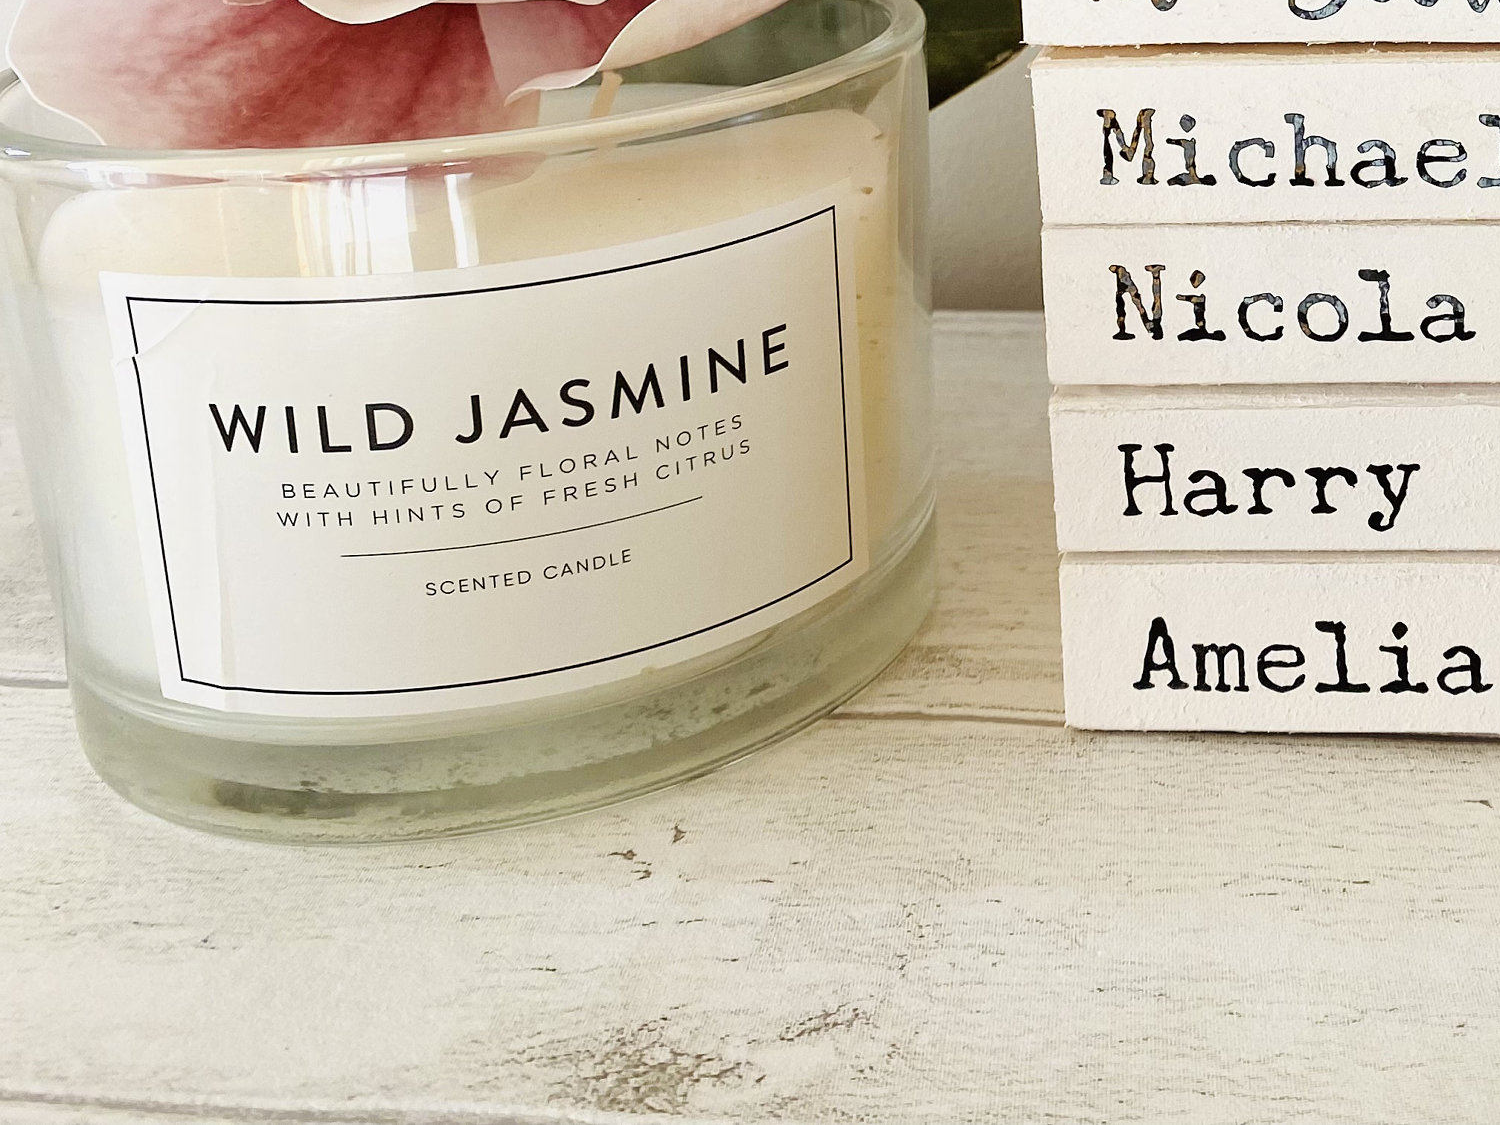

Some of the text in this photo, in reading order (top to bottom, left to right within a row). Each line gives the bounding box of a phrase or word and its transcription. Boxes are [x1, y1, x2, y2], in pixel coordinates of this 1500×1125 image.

[1108, 263, 1477, 343] Nicola
[208, 323, 790, 454] WILD JASMINE
[276, 439, 751, 527] WITH HINTS OF FRESH CITRUS
[281, 414, 743, 499] BEAUTIFULLY FLORAL NOTES
[1117, 442, 1421, 532] Harry
[425, 548, 632, 597] SCENTED CANDLE
[1132, 616, 1494, 696] Amelia
